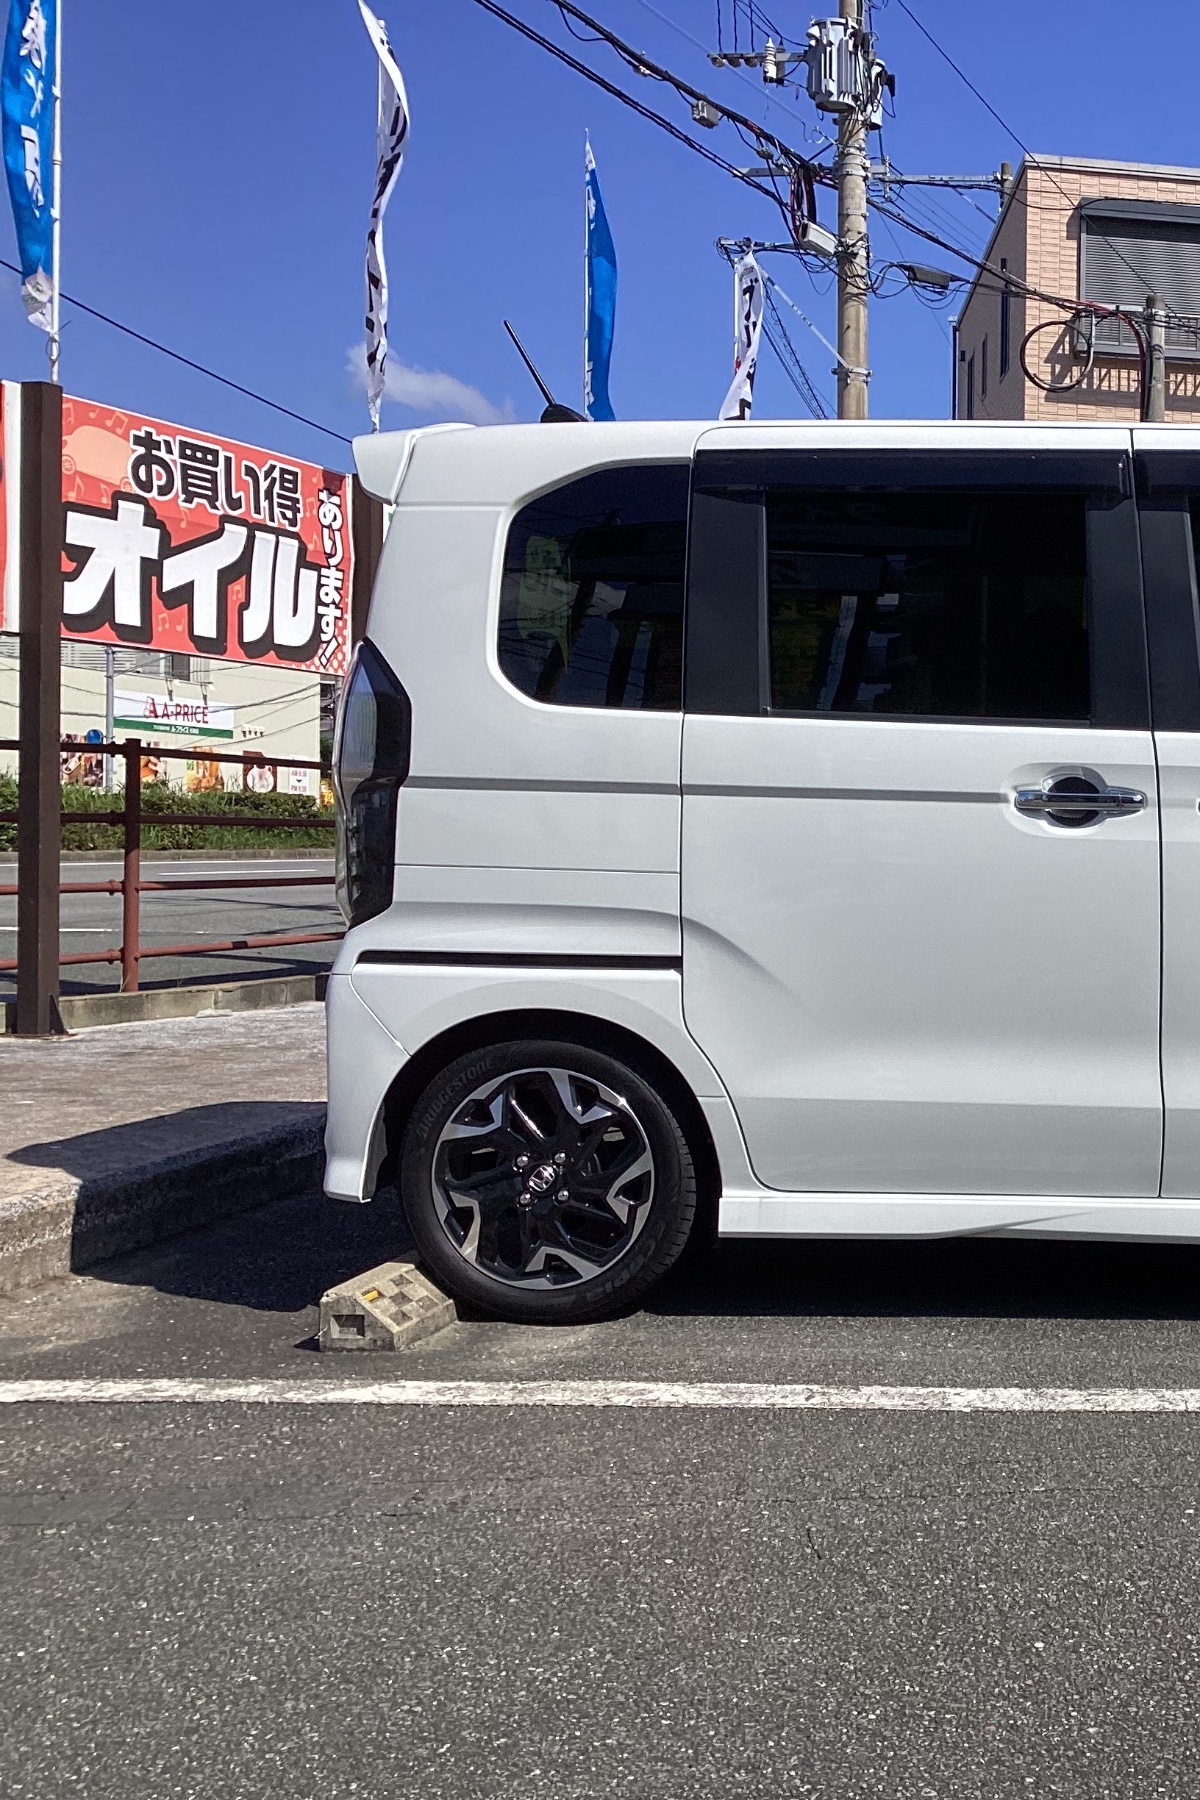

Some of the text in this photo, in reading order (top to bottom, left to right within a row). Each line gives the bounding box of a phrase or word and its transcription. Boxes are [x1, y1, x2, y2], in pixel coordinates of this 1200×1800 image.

[130, 429, 303, 531] お買い得
[62, 497, 320, 654] オイル
[317, 489, 344, 669] あります!
